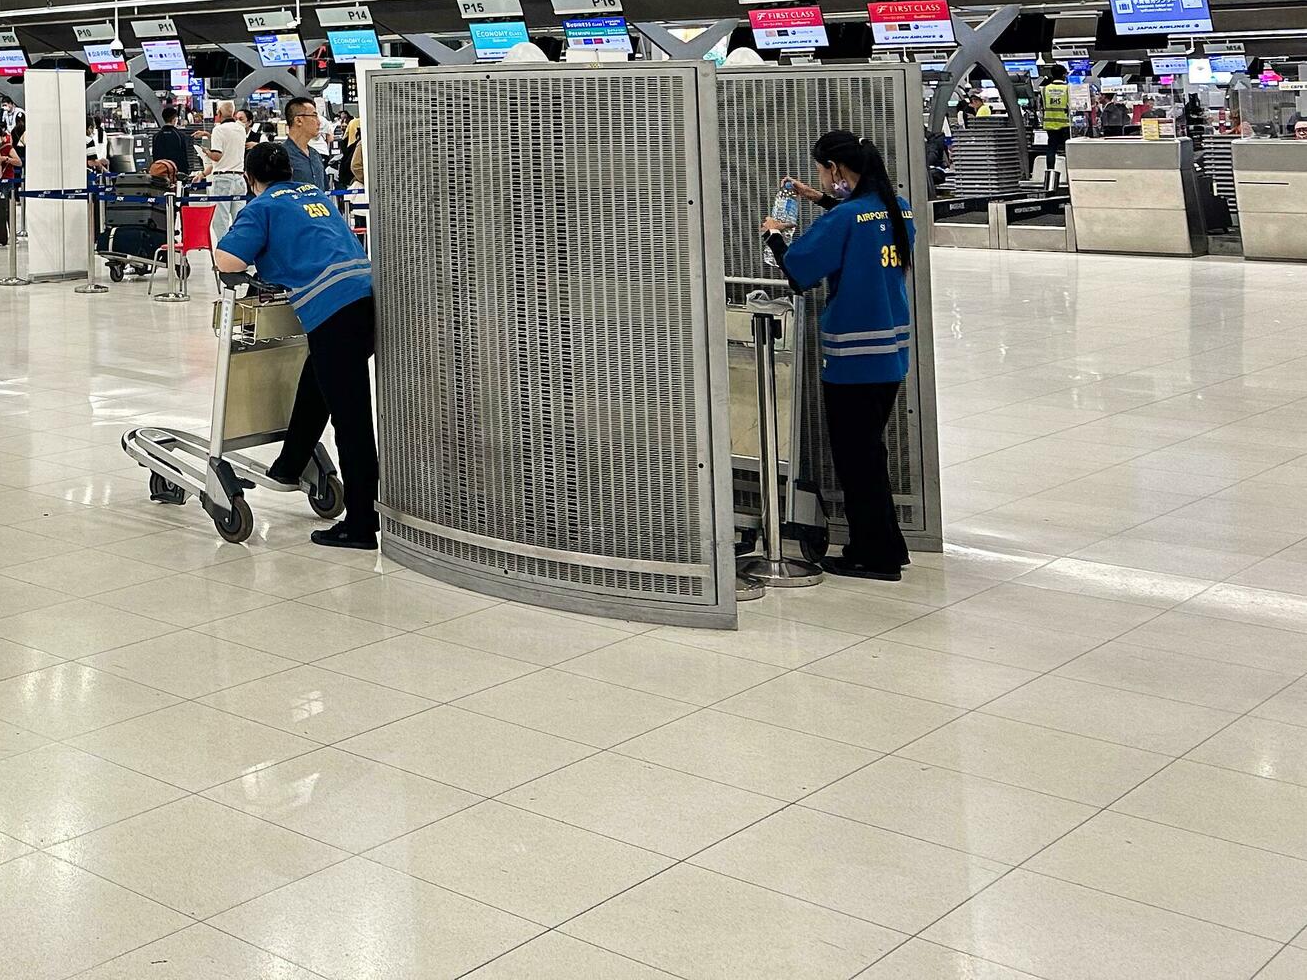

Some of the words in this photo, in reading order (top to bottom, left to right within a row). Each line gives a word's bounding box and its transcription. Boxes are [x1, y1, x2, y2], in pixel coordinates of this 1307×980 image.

[462, 2, 485, 14] P15
[347, 10, 368, 21] P14
[247, 17, 266, 27] P12
[158, 23, 175, 32] P11
[76, 29, 92, 38] P10
[475, 30, 508, 38] ECONOMY
[1, 35, 16, 43] P09
[333, 37, 361, 45] ECONOMY
[302, 202, 331, 218] 259
[856, 210, 889, 223] AIRPORT
